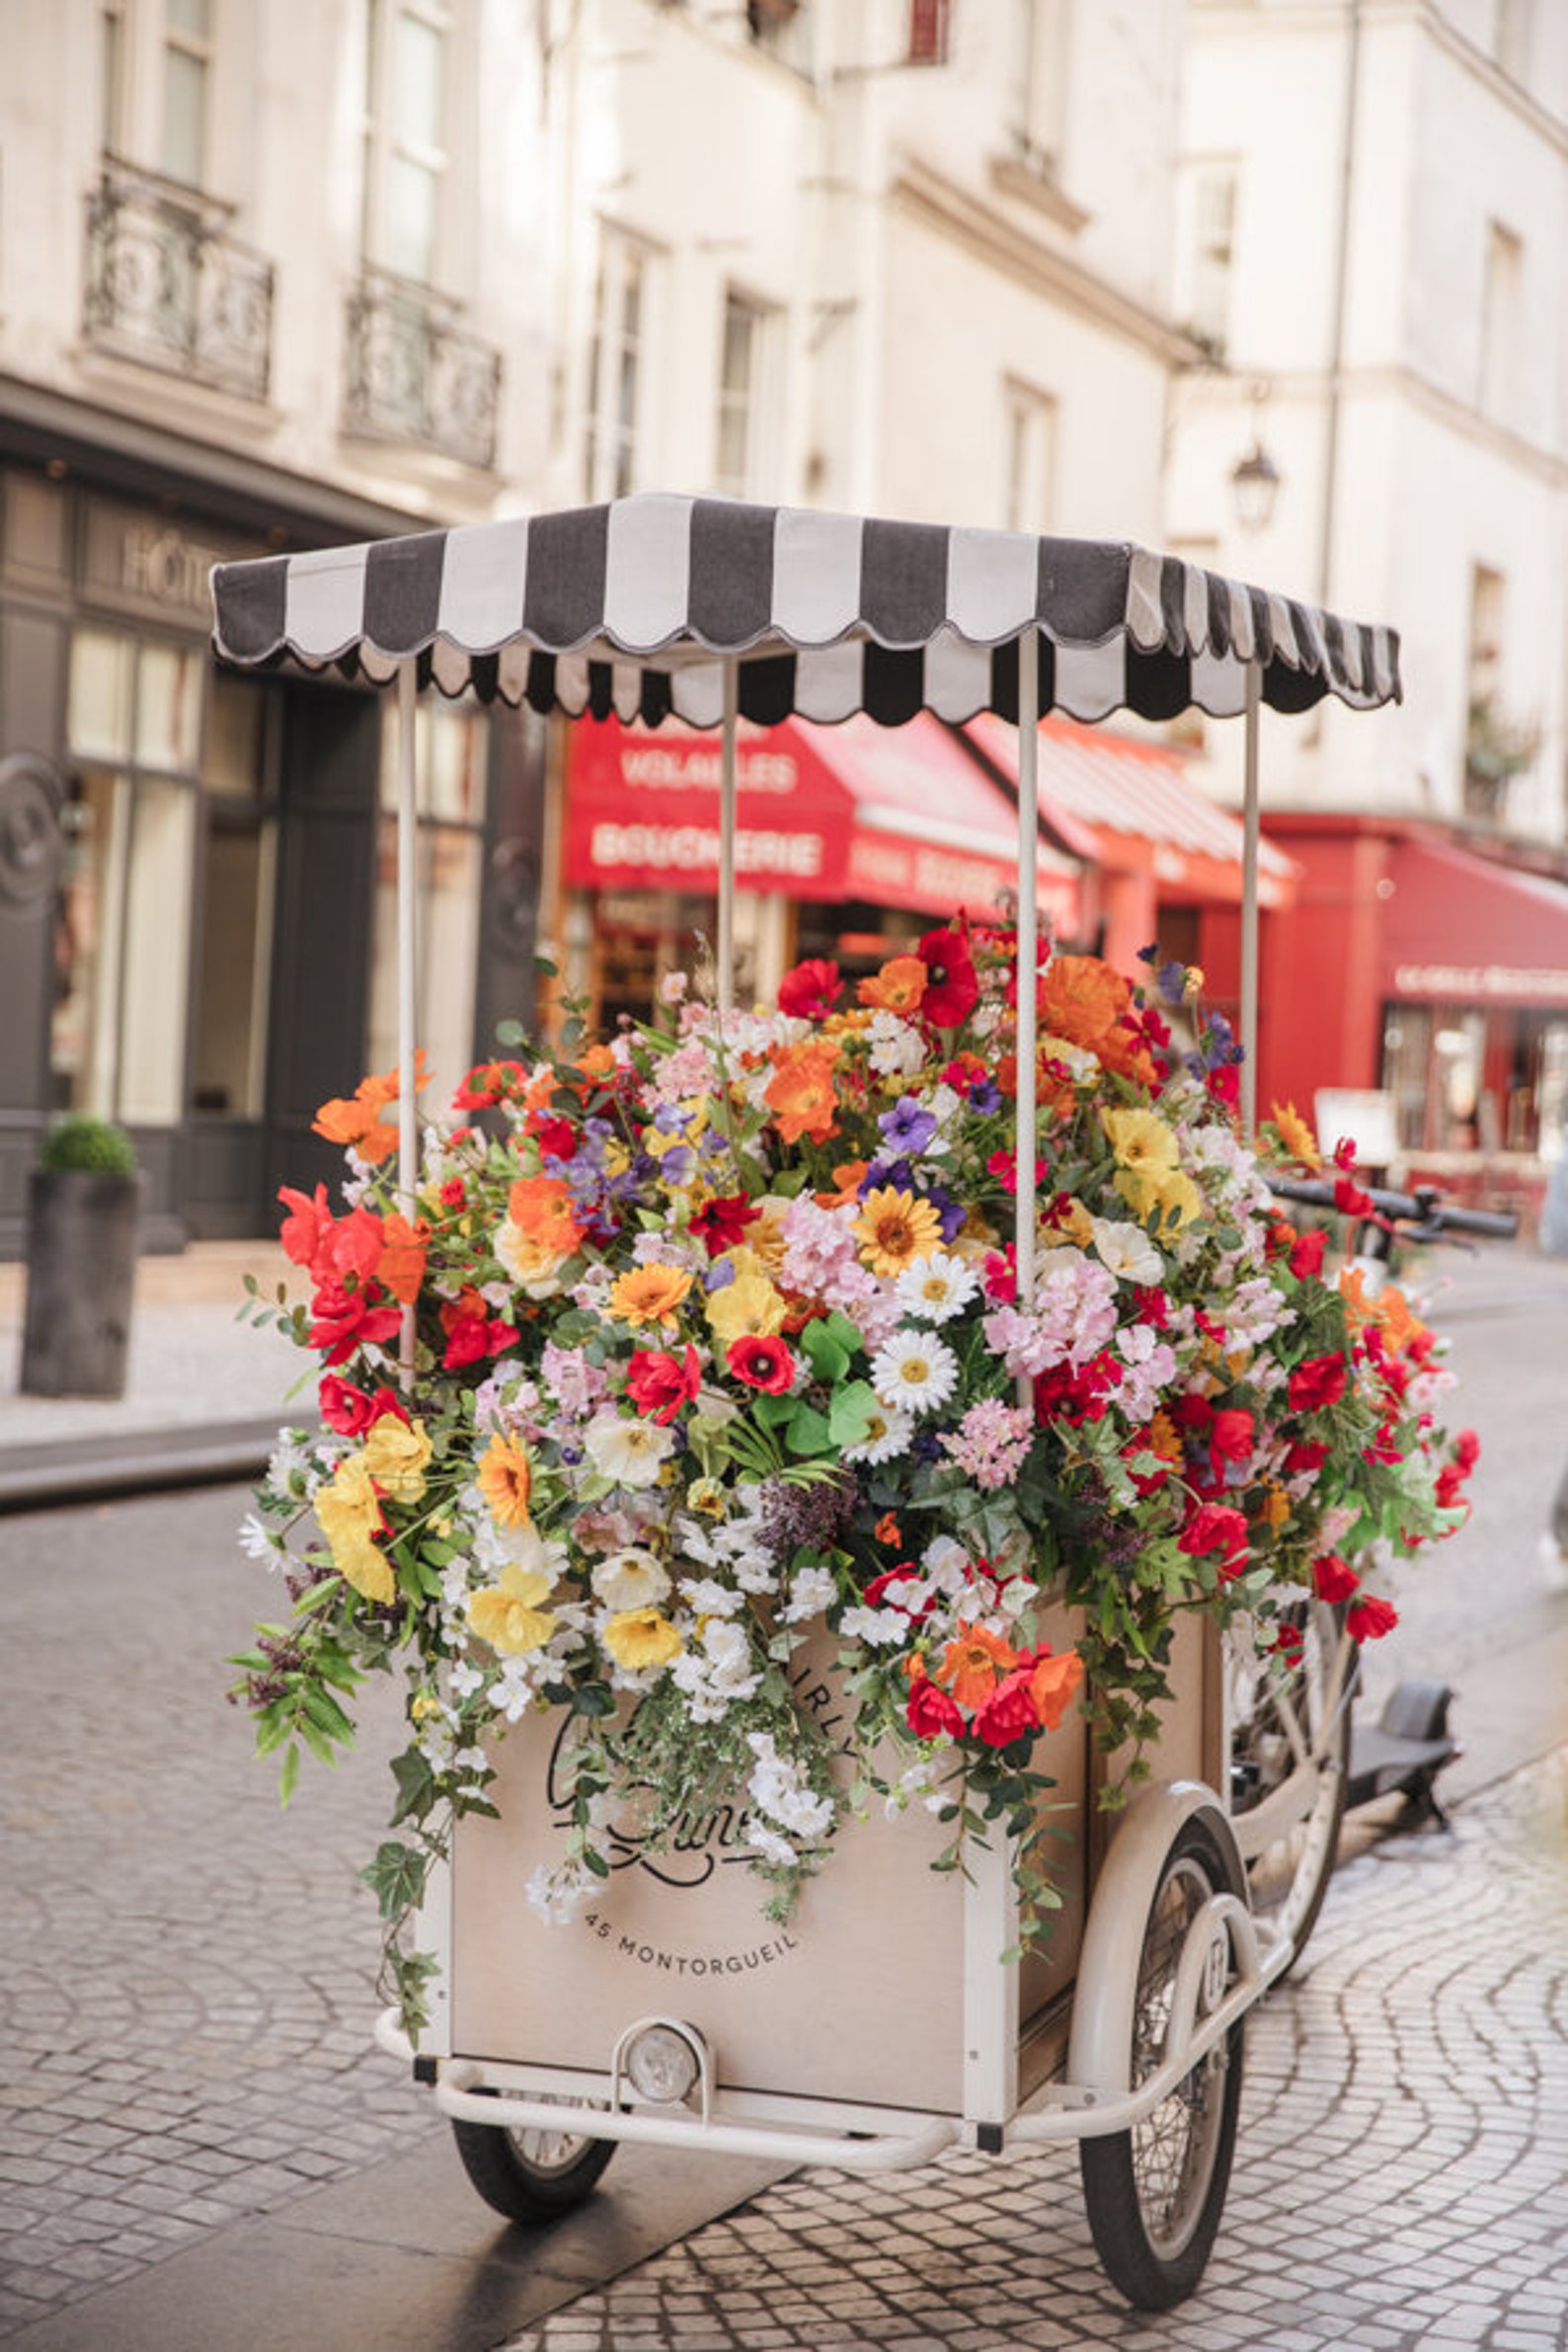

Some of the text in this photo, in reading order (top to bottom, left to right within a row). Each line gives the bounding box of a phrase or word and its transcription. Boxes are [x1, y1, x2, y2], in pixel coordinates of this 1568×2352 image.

[121, 523, 214, 610] HÔT
[621, 749, 796, 793] VOLAILES
[591, 823, 823, 876] BOUCHERIE
[793, 1667, 859, 1757] IRLY
[585, 1913, 798, 1976] 45 MONTORGUEIL
